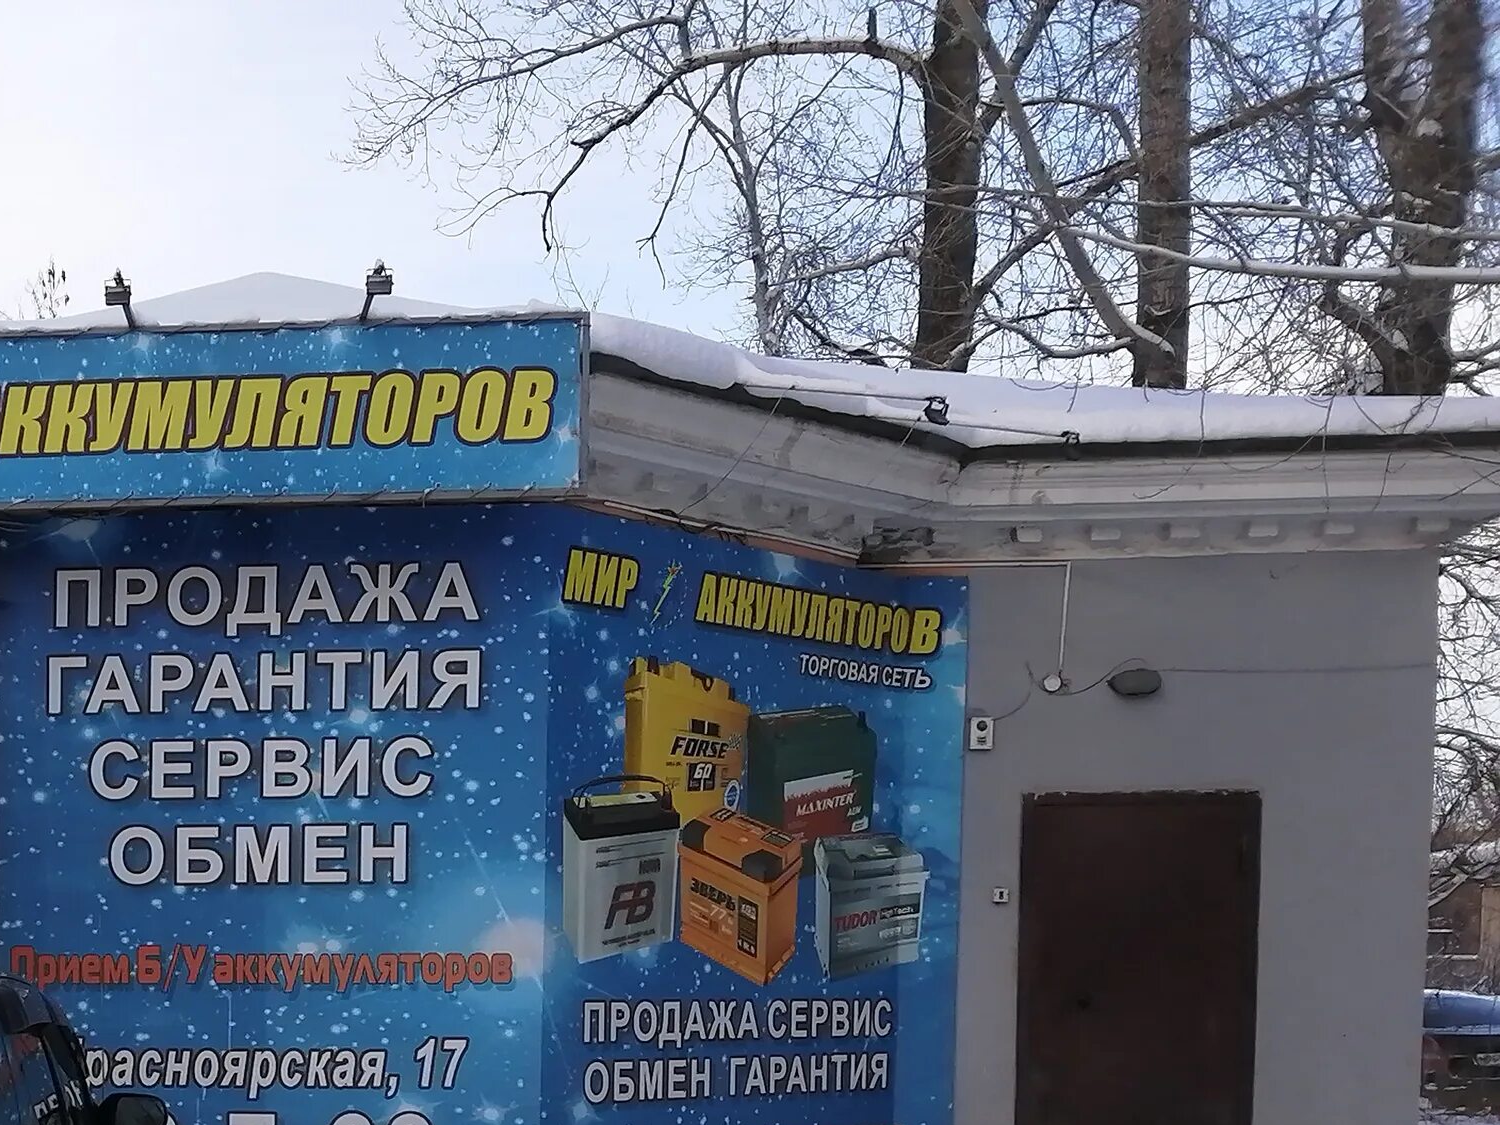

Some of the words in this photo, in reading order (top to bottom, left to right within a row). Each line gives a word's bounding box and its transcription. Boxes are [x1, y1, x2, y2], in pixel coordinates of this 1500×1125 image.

[55, 562, 480, 637] ПРОДАЖА
[564, 548, 639, 609] МИР
[695, 573, 942, 655] АККУМУЛЯТОРОВ
[46, 649, 484, 714] ГАРАНТИЯ
[799, 654, 880, 685] ТОРГОВАЯ
[882, 665, 931, 689] СЕТЬ
[89, 737, 434, 800] СЕРВИС
[670, 735, 729, 759] FORSE
[693, 763, 712, 779] 60
[795, 792, 855, 817] MAXINTER
[110, 824, 410, 886] ОБМЕН
[604, 880, 657, 930] FB
[834, 911, 878, 934] TUDOR
[11, 945, 130, 991] Прием
[137, 943, 208, 993] Б/У
[213, 951, 514, 993] аккумуляторов
[583, 1000, 759, 1049] ПРОДАЖА
[767, 1000, 893, 1039] СЕРВИС
[78, 1038, 400, 1099] расноярская,
[414, 1036, 470, 1089] 17
[584, 1058, 712, 1104] ОБМЕН
[729, 1053, 889, 1096] ГАРАНТИЯ
